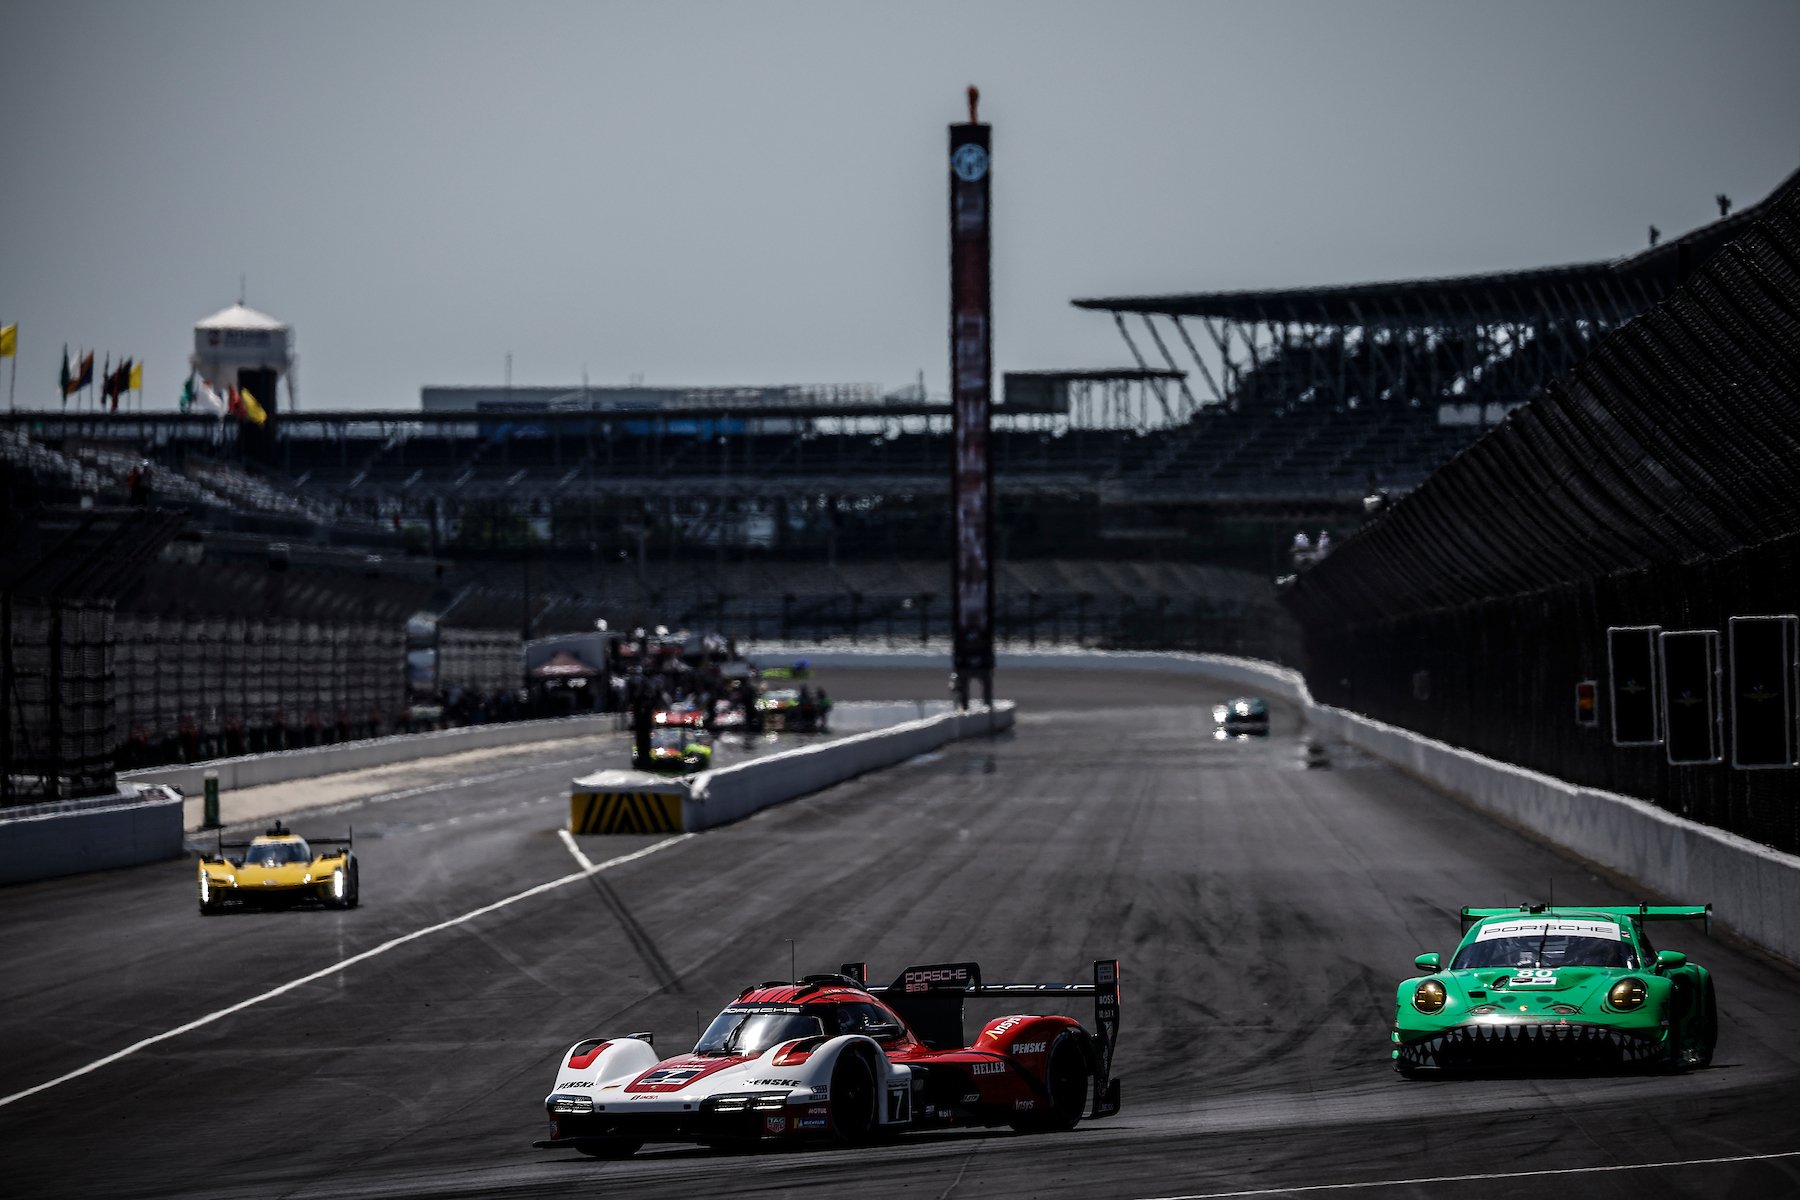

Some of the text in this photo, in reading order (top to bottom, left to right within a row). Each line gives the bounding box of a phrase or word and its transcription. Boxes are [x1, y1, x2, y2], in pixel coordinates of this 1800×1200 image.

[1484, 924, 1613, 934] PORSCHE
[904, 969, 967, 983] PORSCHE
[1516, 969, 1553, 978] 80
[905, 983, 928, 993] 963
[1098, 995, 1114, 1005] BOSS
[1012, 1042, 1047, 1055] PENSKE
[972, 1062, 1006, 1075] HELLER
[893, 1090, 904, 1120] 7
